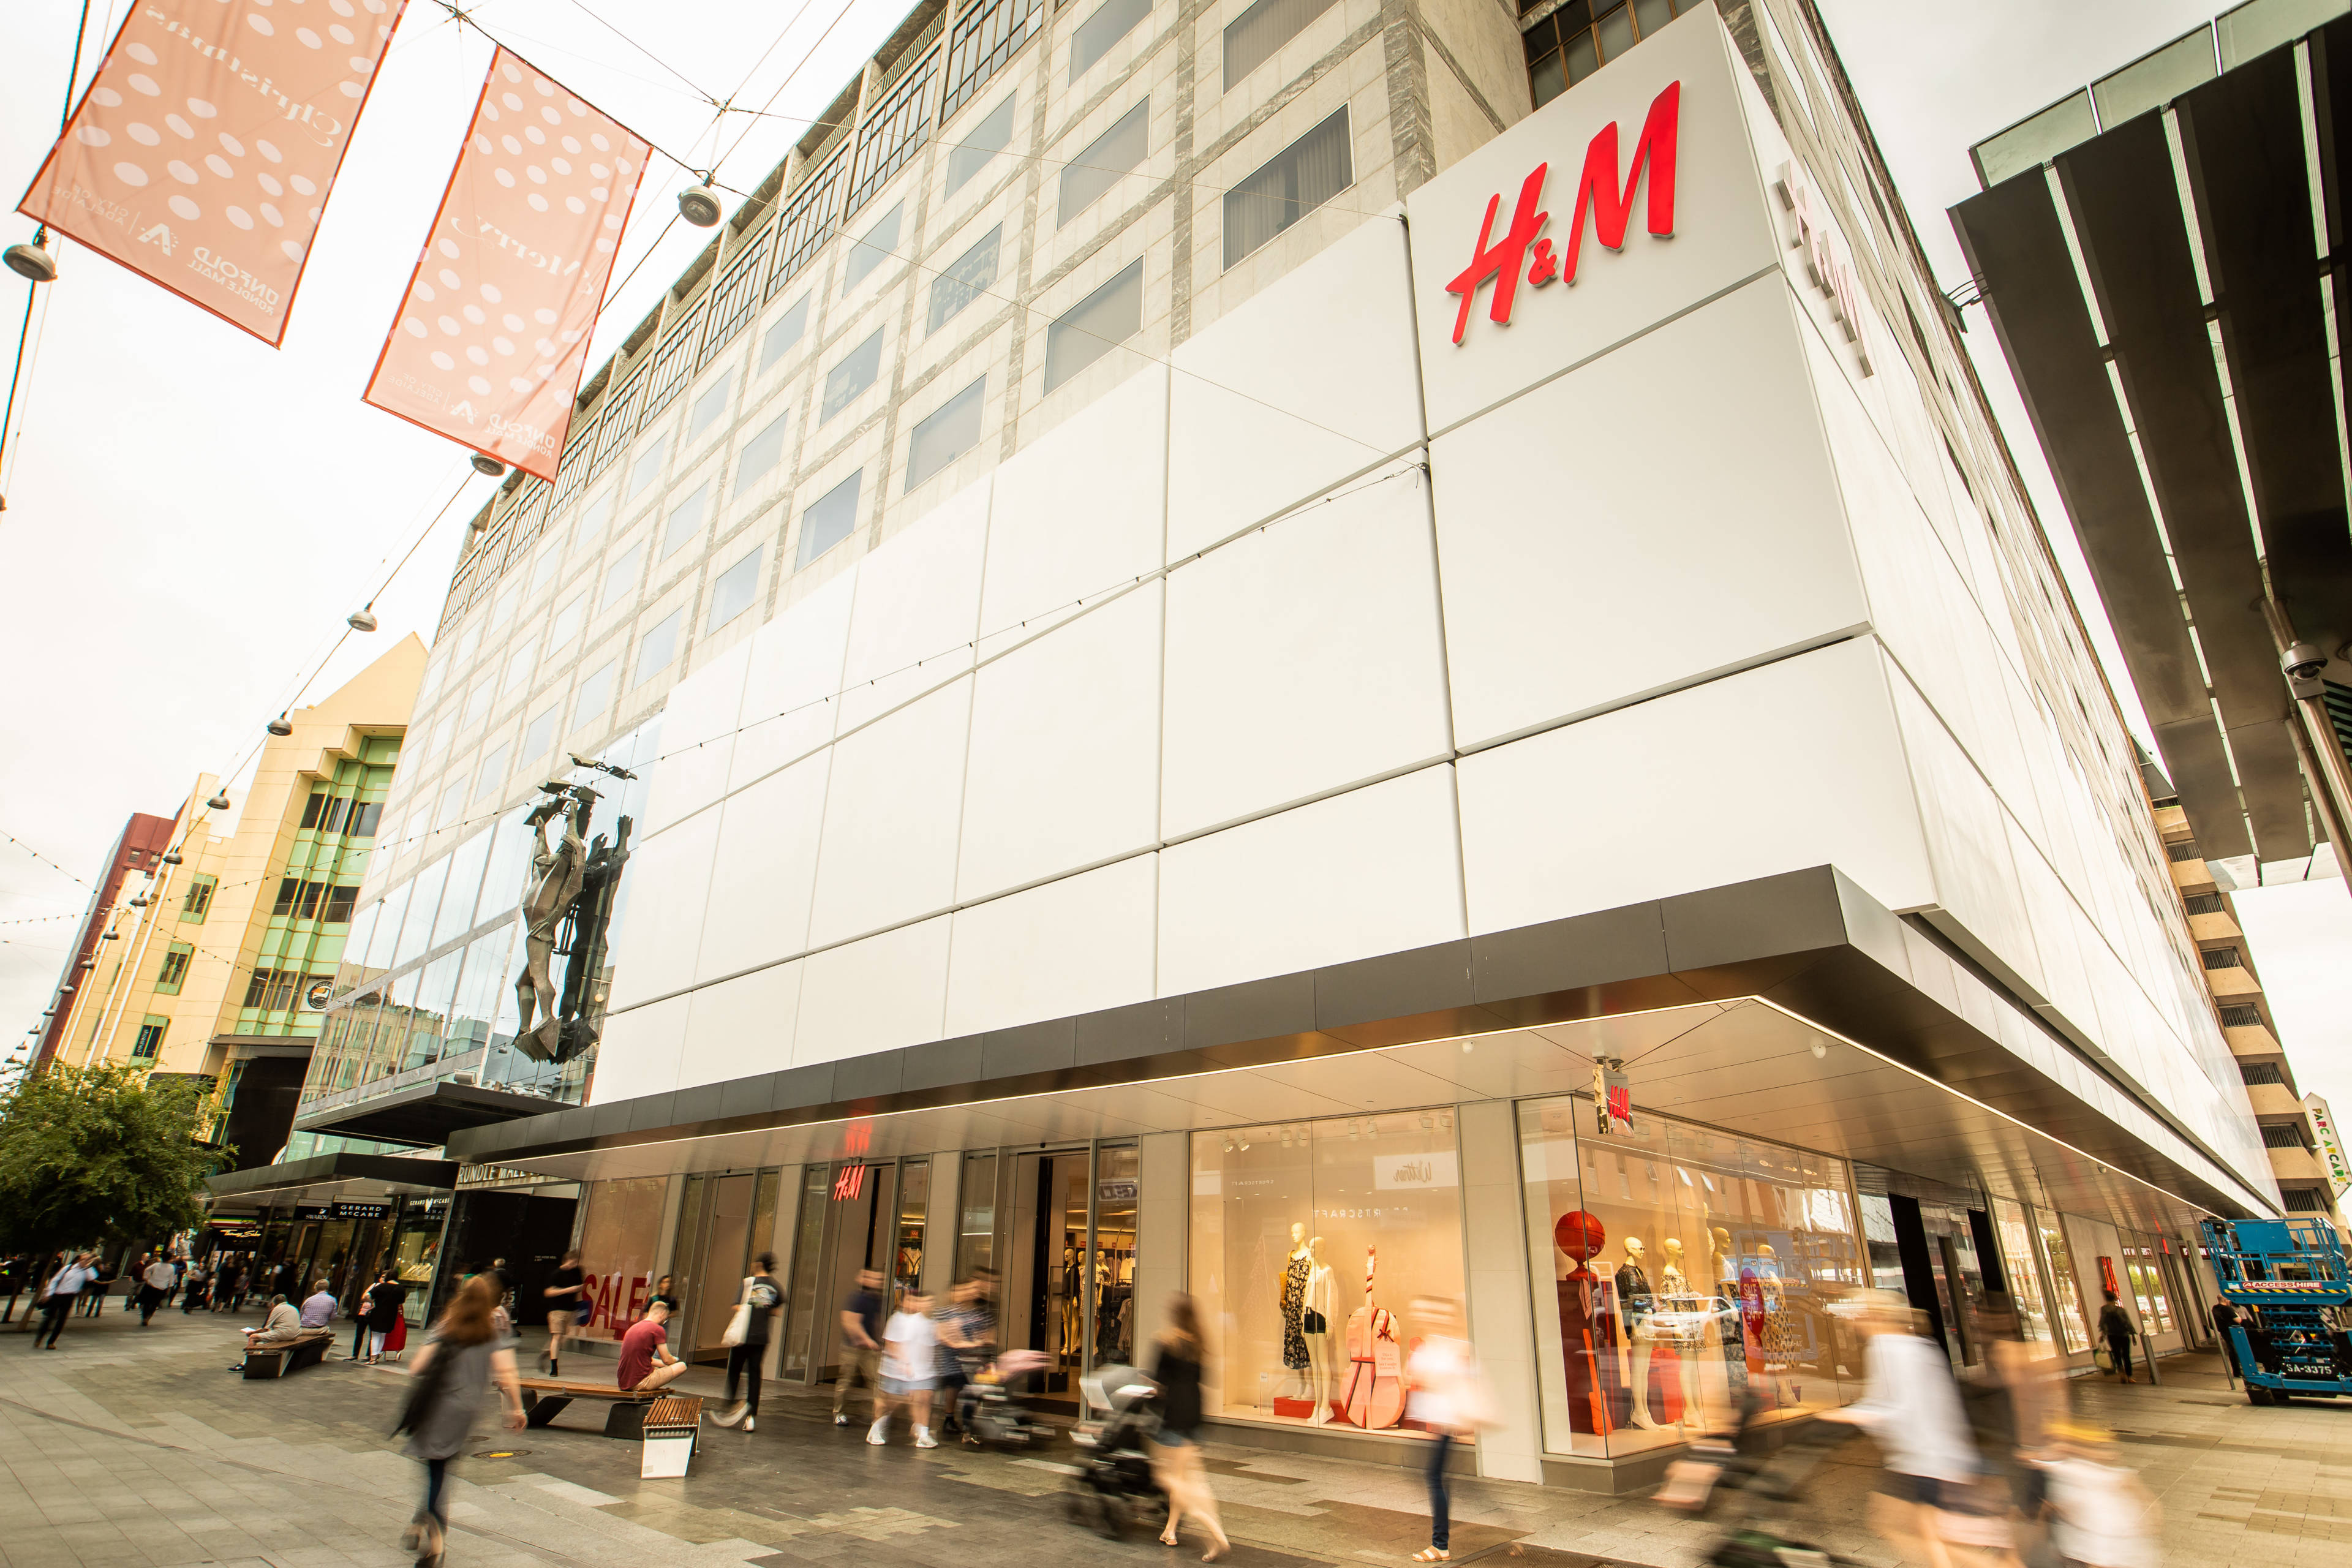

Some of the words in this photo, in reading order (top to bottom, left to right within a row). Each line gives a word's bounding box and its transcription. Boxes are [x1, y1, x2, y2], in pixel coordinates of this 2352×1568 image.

[1446, 80, 1682, 347] H&M
[2312, 1108, 2331, 1135] PARC
[2323, 1140, 2347, 1183] ARCADE
[834, 1164, 865, 1202] H&M
[579, 1274, 651, 1332] SALE
[2286, 1363, 2332, 1374] SA-3375
